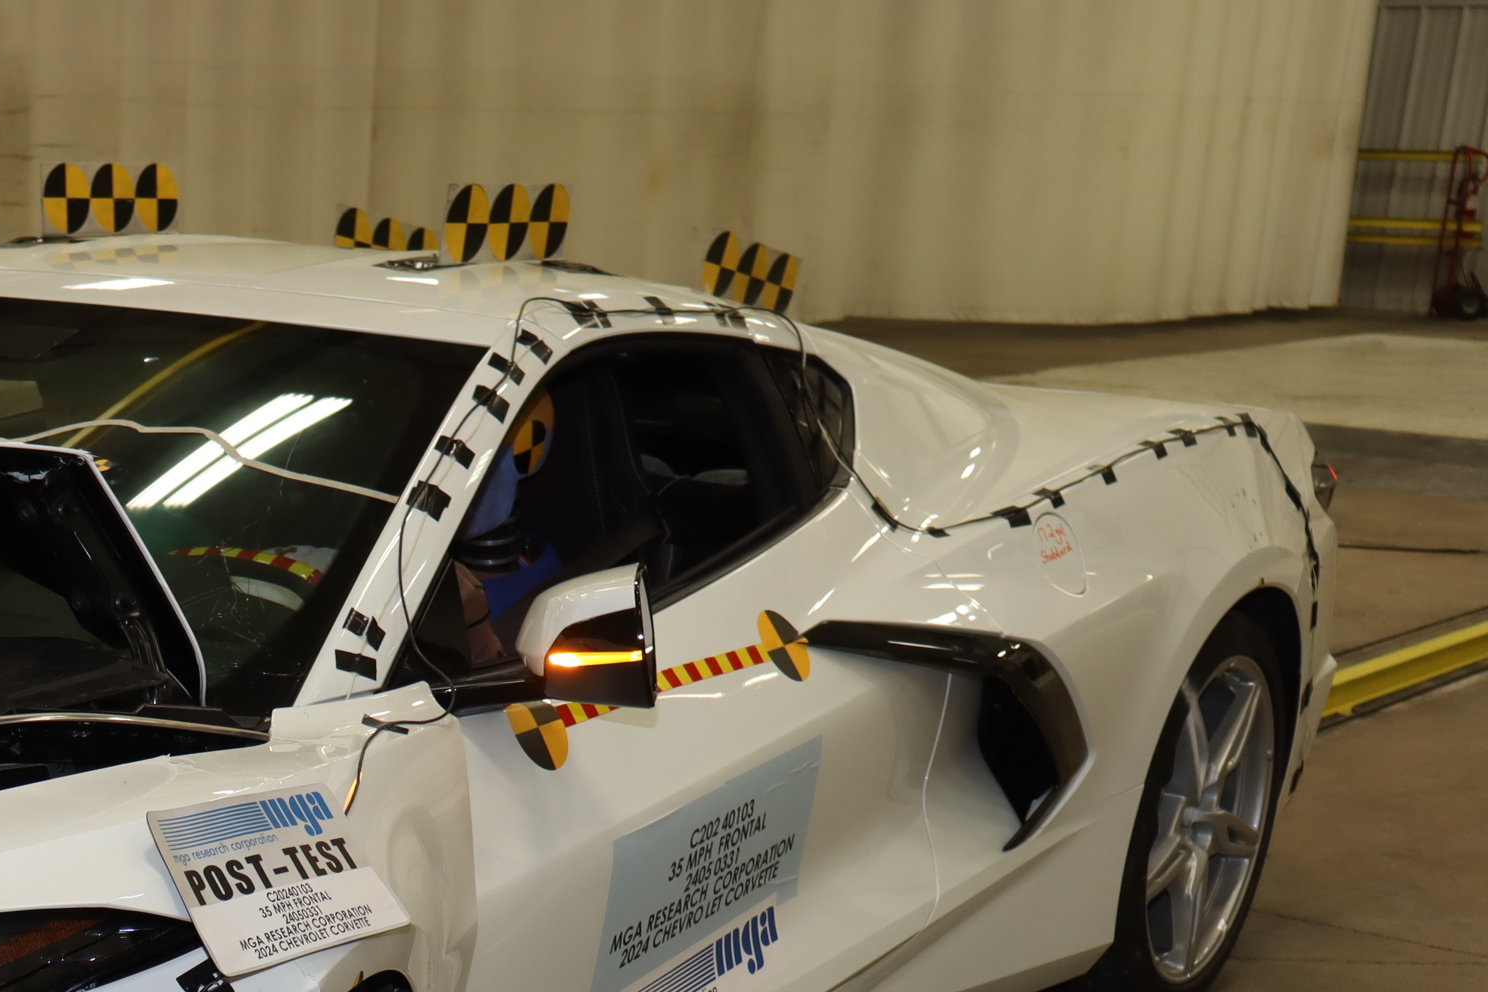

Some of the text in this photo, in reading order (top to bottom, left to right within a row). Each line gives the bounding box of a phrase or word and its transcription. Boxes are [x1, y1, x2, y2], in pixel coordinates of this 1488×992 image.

[259, 791, 334, 836] mga
[173, 832, 279, 866] mga research corporation
[668, 812, 767, 882] 35 MPH FRONTAL
[184, 837, 358, 906] POST-TEST
[267, 882, 314, 903] C20240103
[610, 833, 795, 955] MGA RESEARCH CORPORATION
[239, 904, 373, 951] MGA RESEARCH CORPORATION
[259, 890, 332, 919] 35 MPH FRONTAL
[282, 905, 323, 925] 24050331
[619, 935, 650, 969] 2024
[725, 860, 780, 907] CORVETTE
[255, 916, 371, 960] 2024 CHEVROLET CORVETTE
[715, 905, 779, 977] mga
